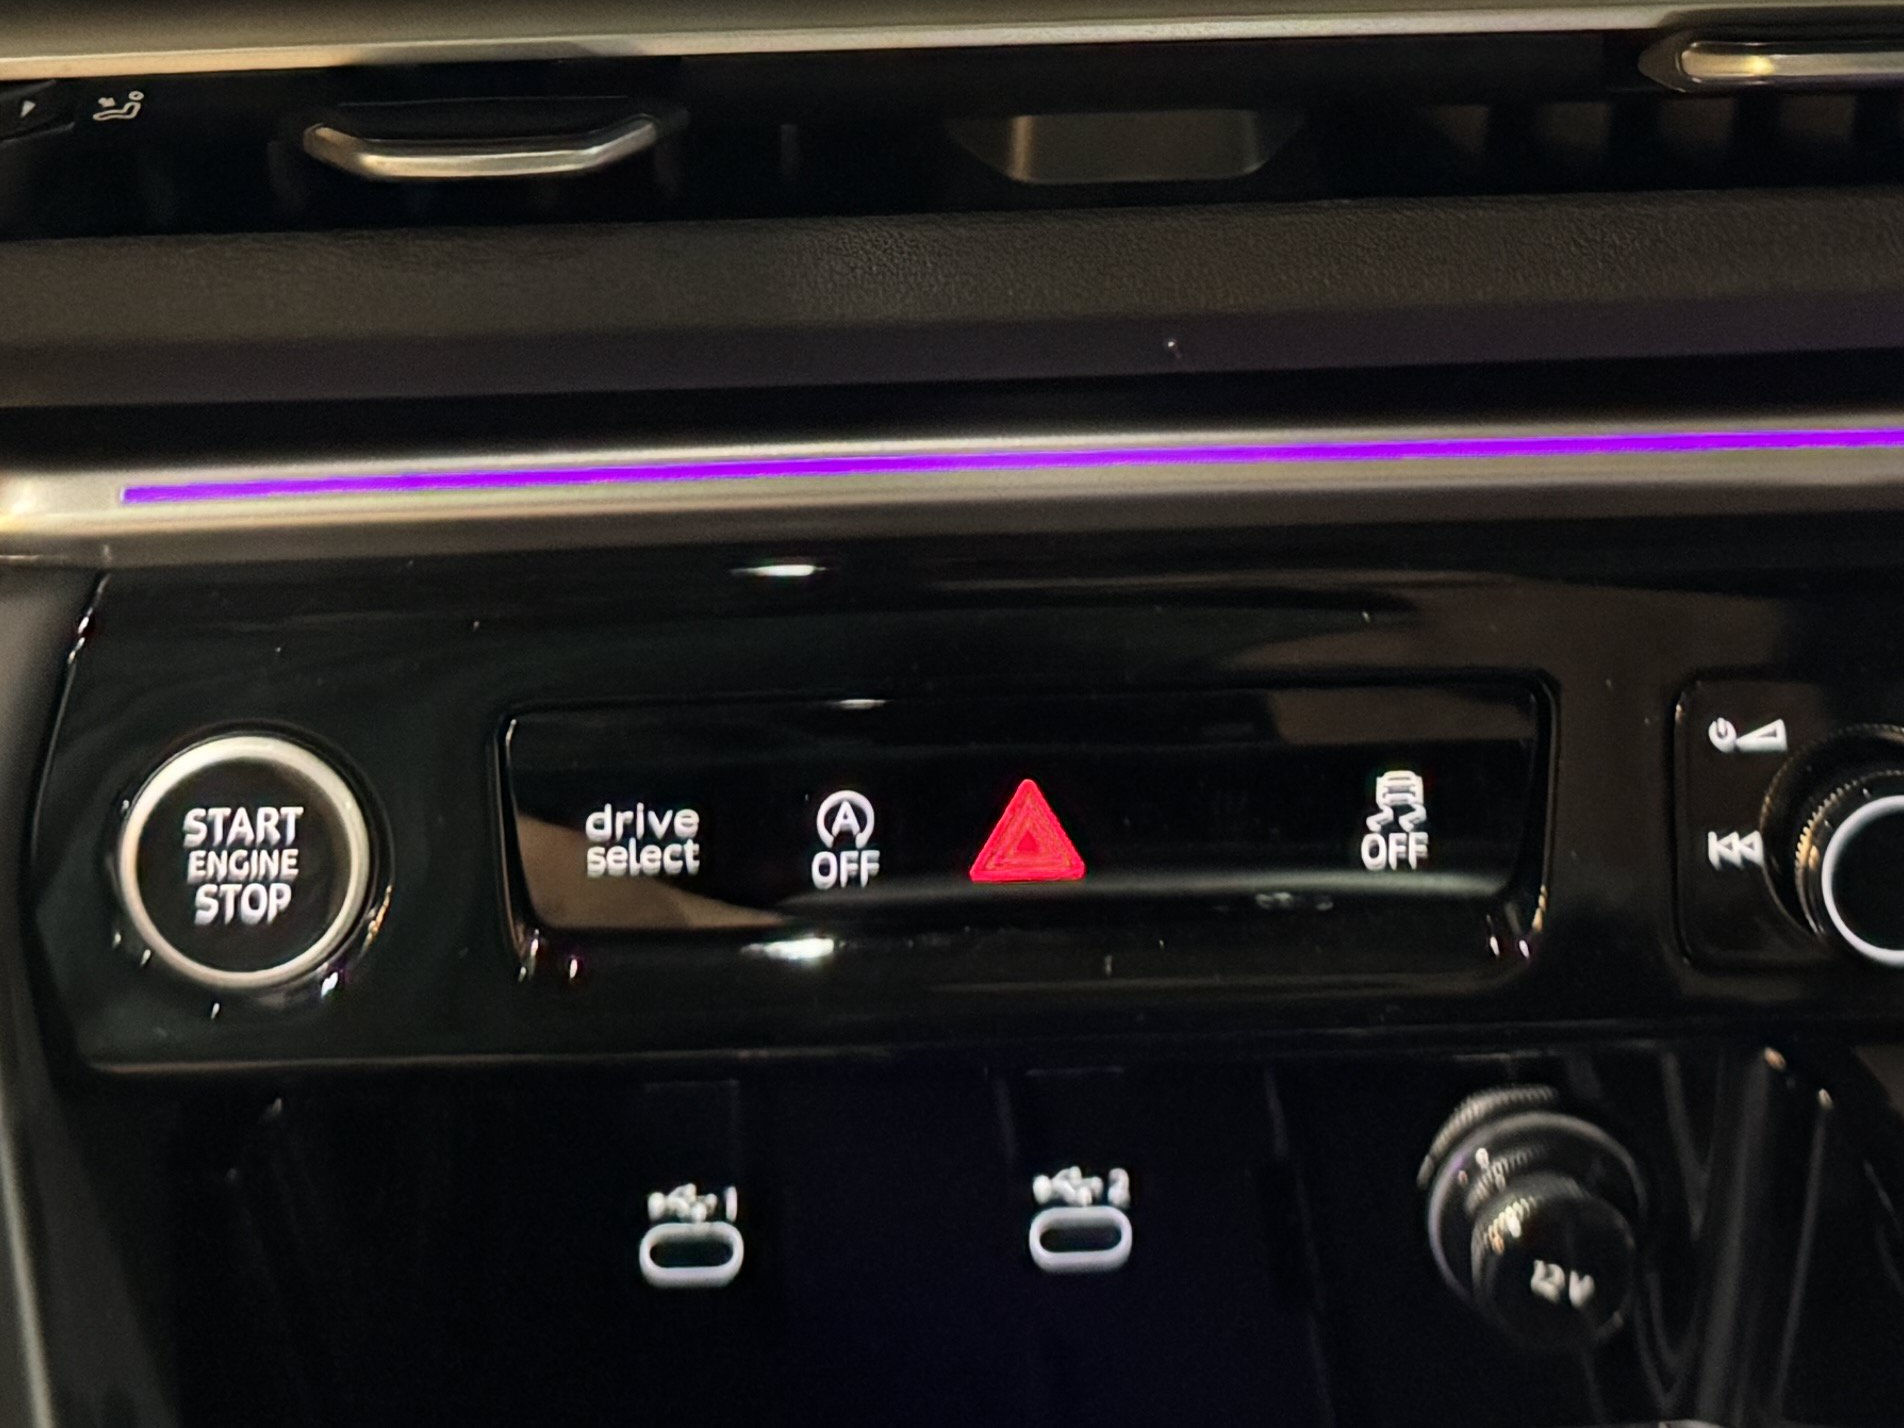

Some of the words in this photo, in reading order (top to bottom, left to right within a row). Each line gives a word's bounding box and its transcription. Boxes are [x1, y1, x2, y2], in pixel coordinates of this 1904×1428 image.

[183, 806, 304, 848] START
[585, 802, 700, 842] drive
[187, 848, 299, 884] ENGINE
[586, 837, 700, 879] select
[811, 850, 881, 890] OFF
[1360, 832, 1429, 871] OFF
[194, 882, 292, 926] STOP
